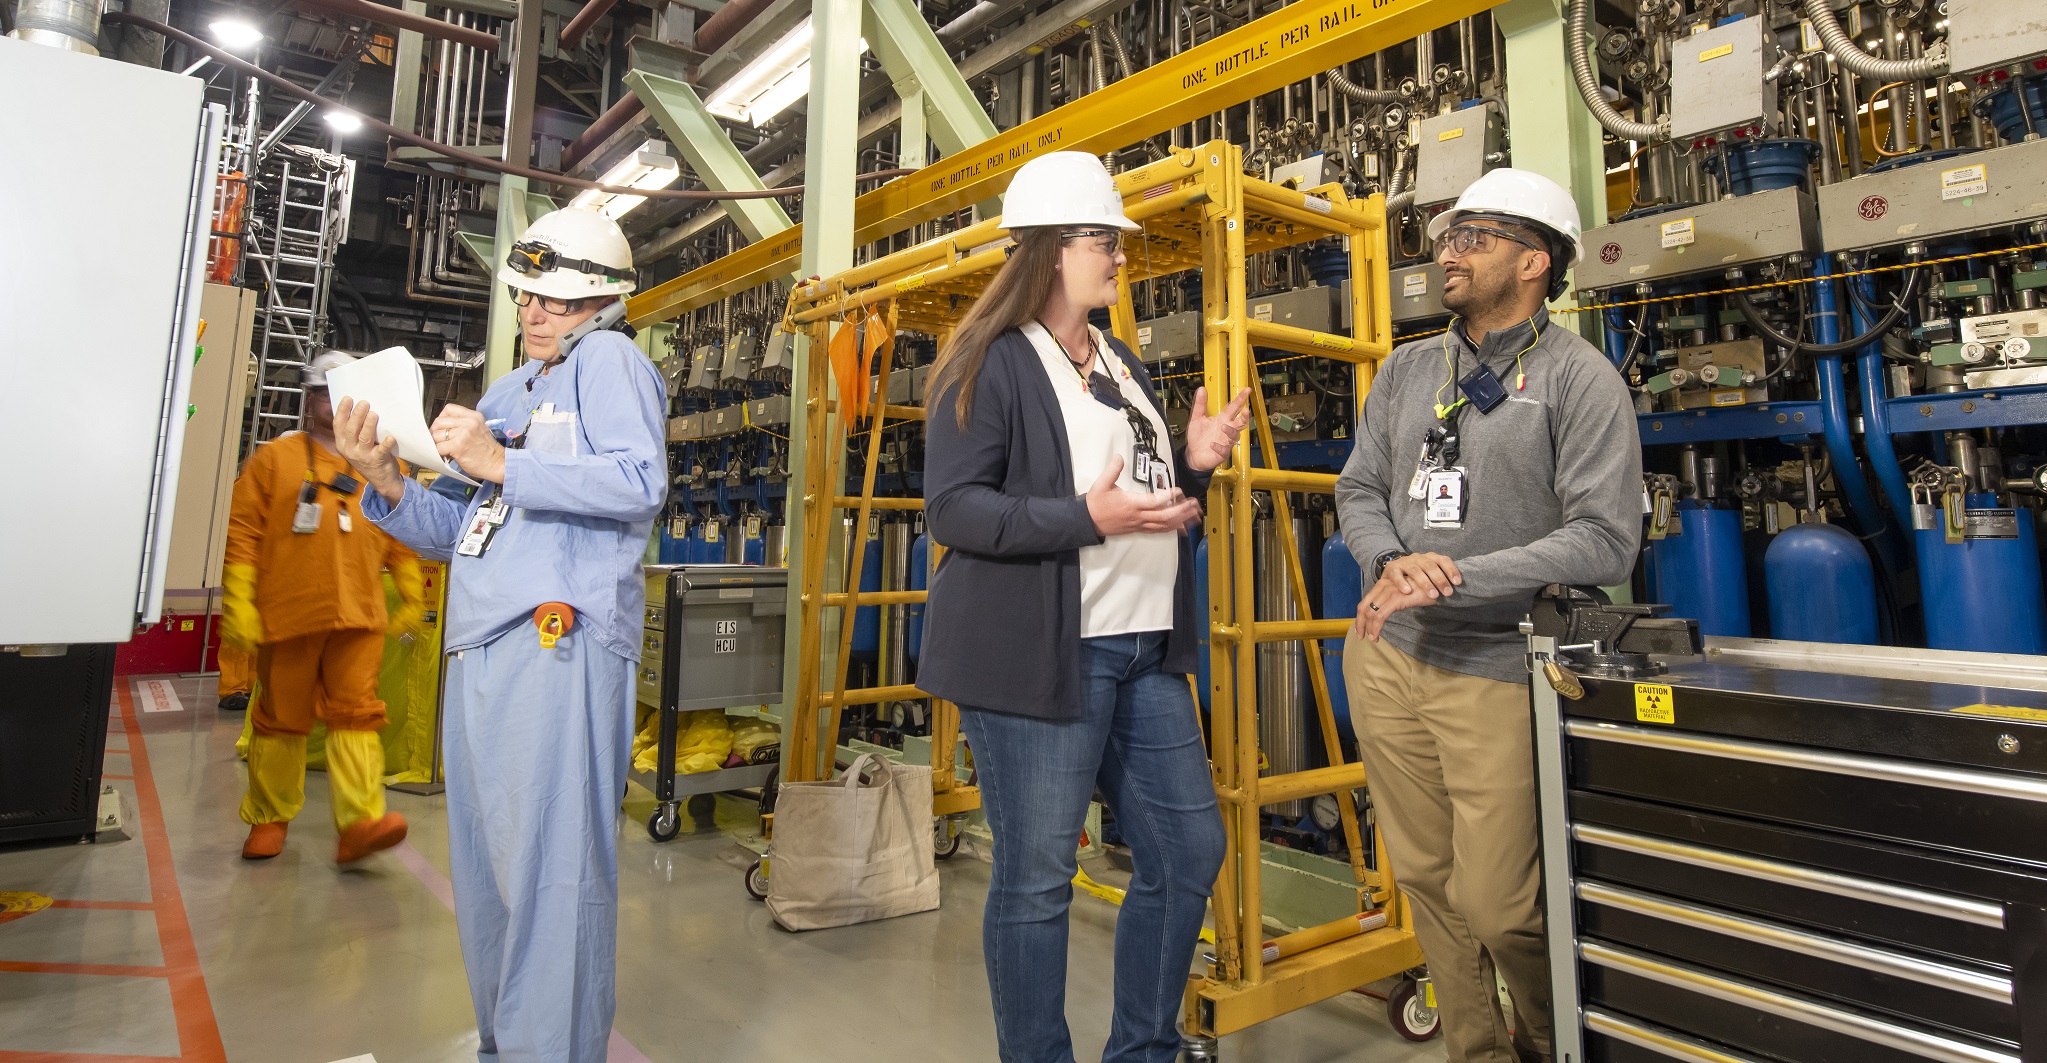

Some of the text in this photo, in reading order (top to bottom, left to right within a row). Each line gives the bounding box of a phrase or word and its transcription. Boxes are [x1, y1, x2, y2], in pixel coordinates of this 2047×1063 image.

[1182, 3, 1362, 90] ONE BOTTLE PER RAIL
[931, 126, 1063, 193] ONE BOTTLE PER RAIL ONLY
[717, 621, 736, 634] EIS
[716, 639, 735, 652] HCU
[1637, 685, 1668, 696] CAUTION
[1639, 707, 1670, 715] RADIOACTIVE
[1643, 712, 1667, 720] MATERIAL
